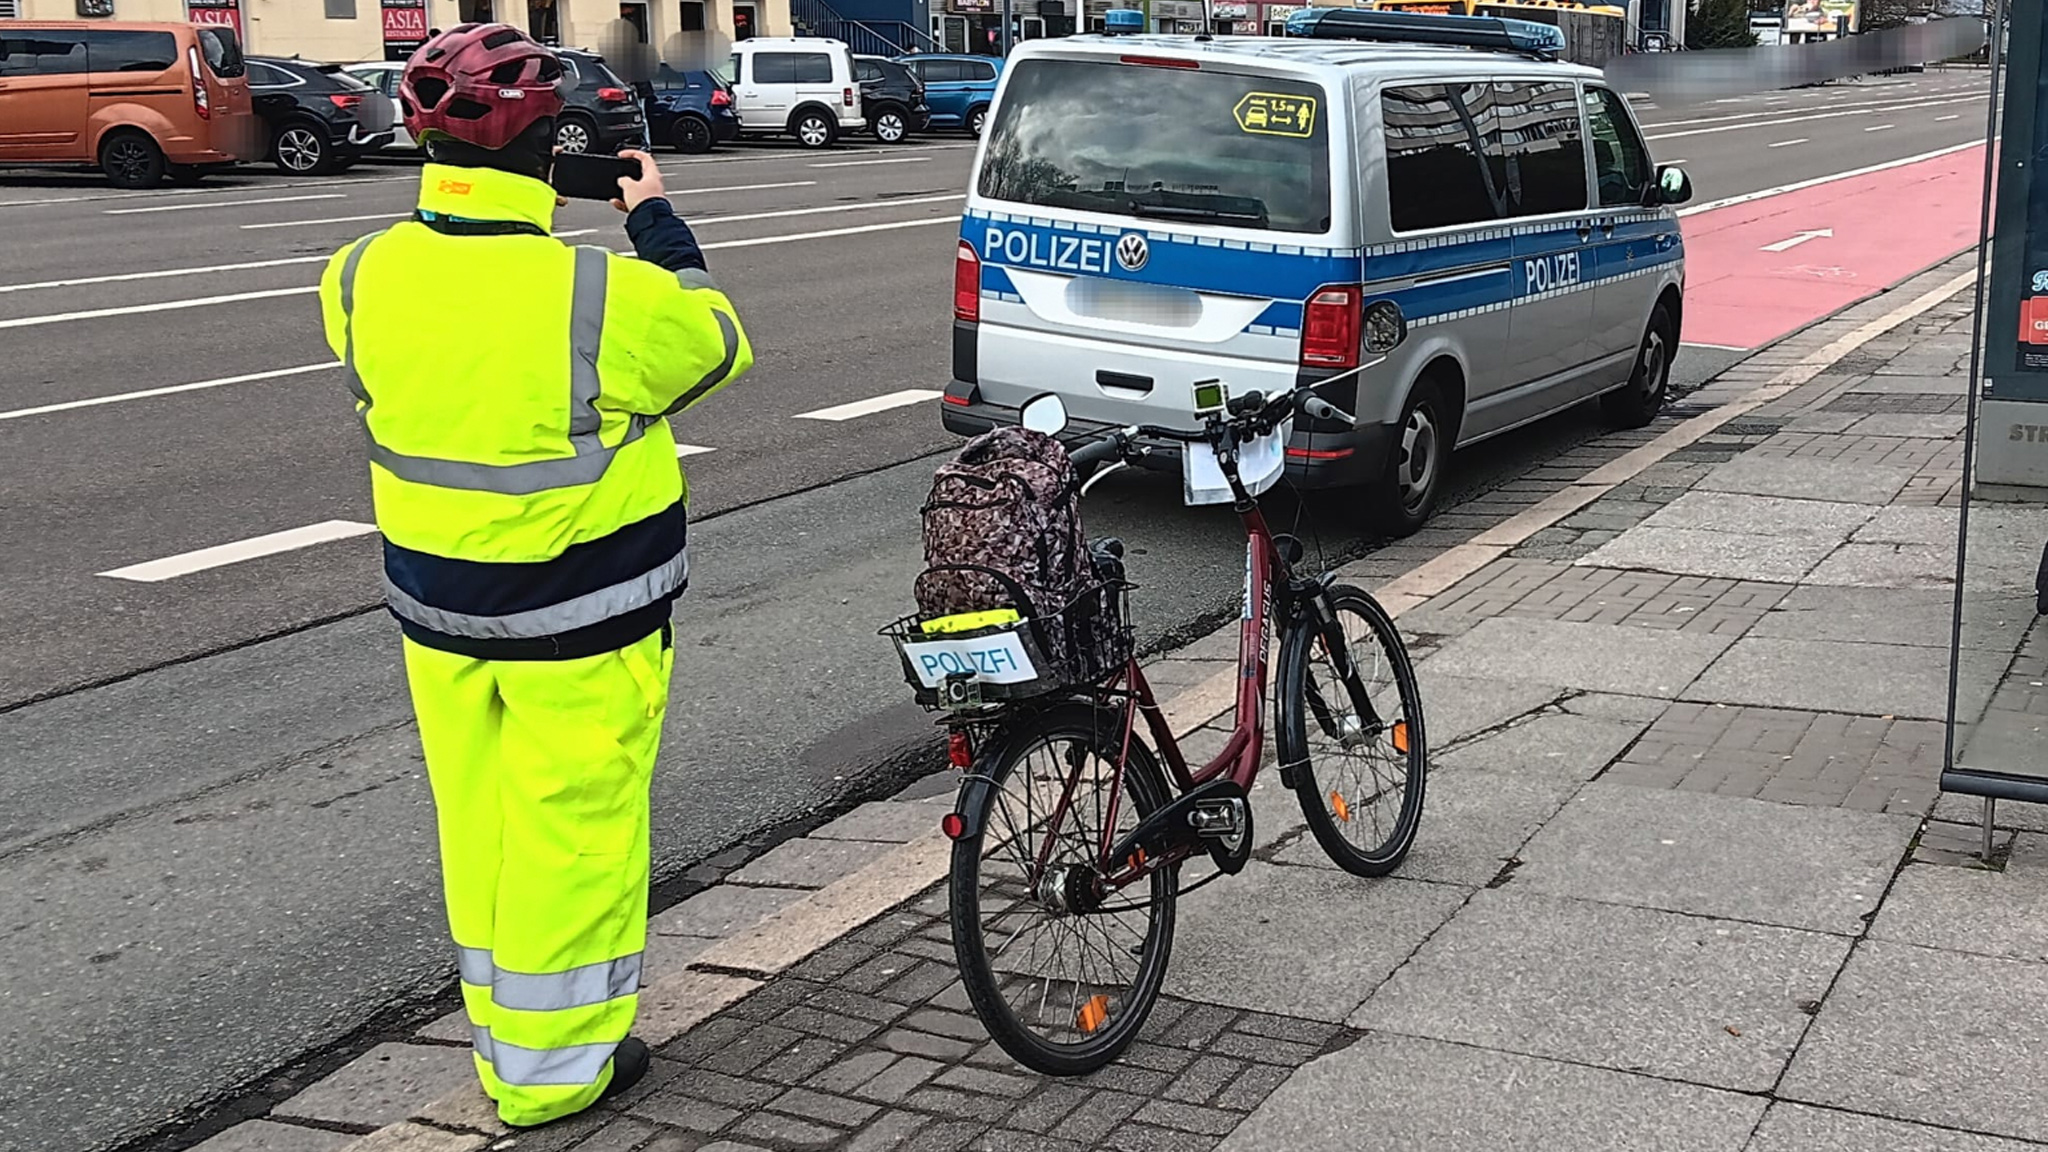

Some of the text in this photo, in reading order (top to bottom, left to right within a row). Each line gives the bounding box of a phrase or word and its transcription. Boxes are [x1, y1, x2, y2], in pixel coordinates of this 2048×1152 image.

[193, 11, 234, 26] ASIA
[385, 10, 424, 29] ASIA
[984, 227, 1112, 274] POLIZEI
[1525, 251, 1581, 294] POLIZEI
